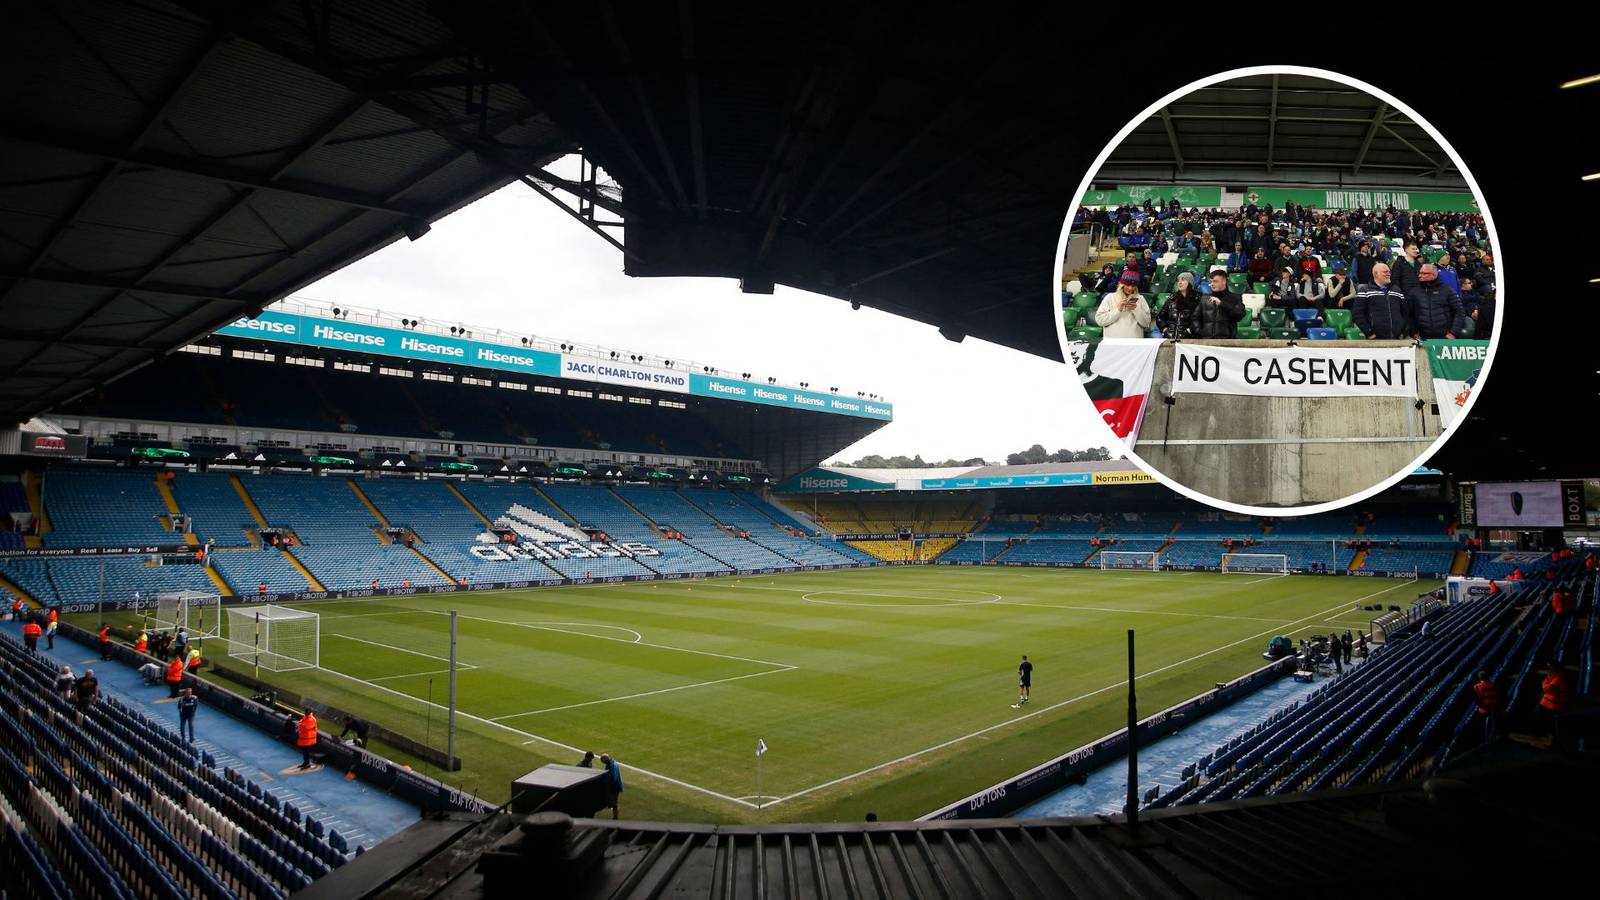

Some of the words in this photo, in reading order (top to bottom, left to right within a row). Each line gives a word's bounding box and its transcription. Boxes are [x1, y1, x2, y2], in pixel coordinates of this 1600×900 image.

[1326, 190, 1372, 210] NORTHERN
[1374, 193, 1409, 211] IRELAND
[229, 317, 296, 335] sense
[314, 325, 385, 347] Hisense
[401, 336, 464, 359] Hisense
[477, 347, 534, 368] Hisense
[566, 361, 596, 376] JACK
[597, 366, 652, 383] CHARLTON
[653, 372, 685, 387] STAND
[1178, 353, 1220, 383] NO
[1243, 357, 1411, 386] CASEMENT
[709, 381, 746, 397] Hisense
[753, 388, 788, 403] Hisense
[793, 394, 825, 408] Hisense
[831, 399, 860, 413] Hisense
[864, 404, 891, 417] Hisense
[800, 476, 849, 490] Hisense
[1567, 488, 1580, 521] BOXT
[39, 548, 74, 556] everyone
[127, 546, 141, 554] Buy
[361, 752, 387, 773] DUFTONS
[1068, 747, 1094, 766] DUFTONS
[970, 784, 1006, 812] DUFTONS
